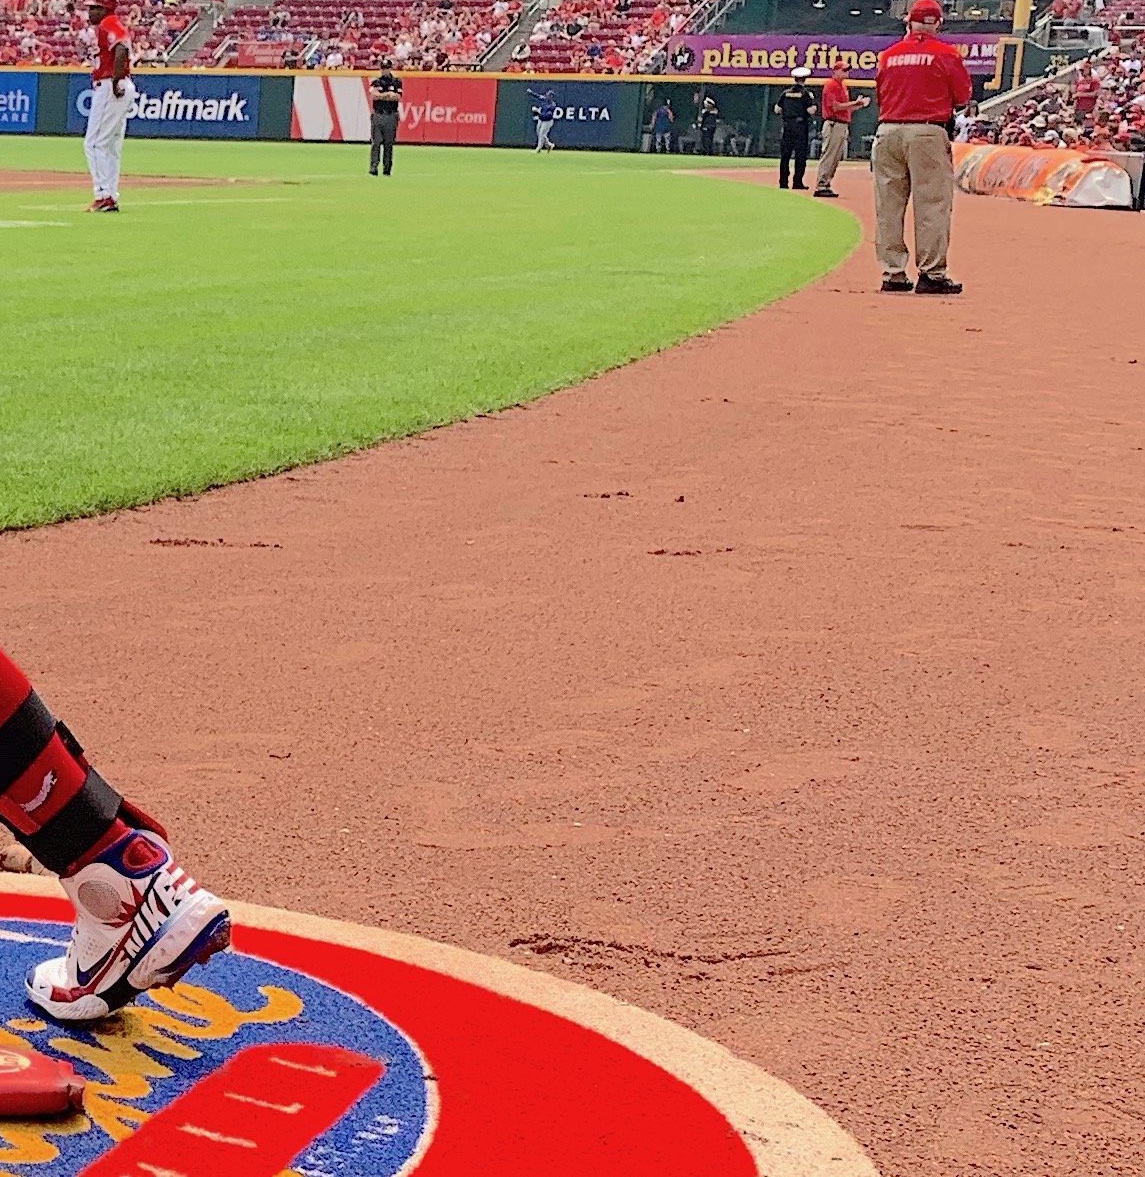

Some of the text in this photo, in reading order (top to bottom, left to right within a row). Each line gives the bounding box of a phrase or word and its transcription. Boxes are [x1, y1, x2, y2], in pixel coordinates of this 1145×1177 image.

[970, 43, 979, 57] A
[701, 43, 798, 73] planet
[887, 53, 935, 68] SECURITY
[554, 106, 611, 121] DELTA
[124, 872, 183, 959] NIKE
